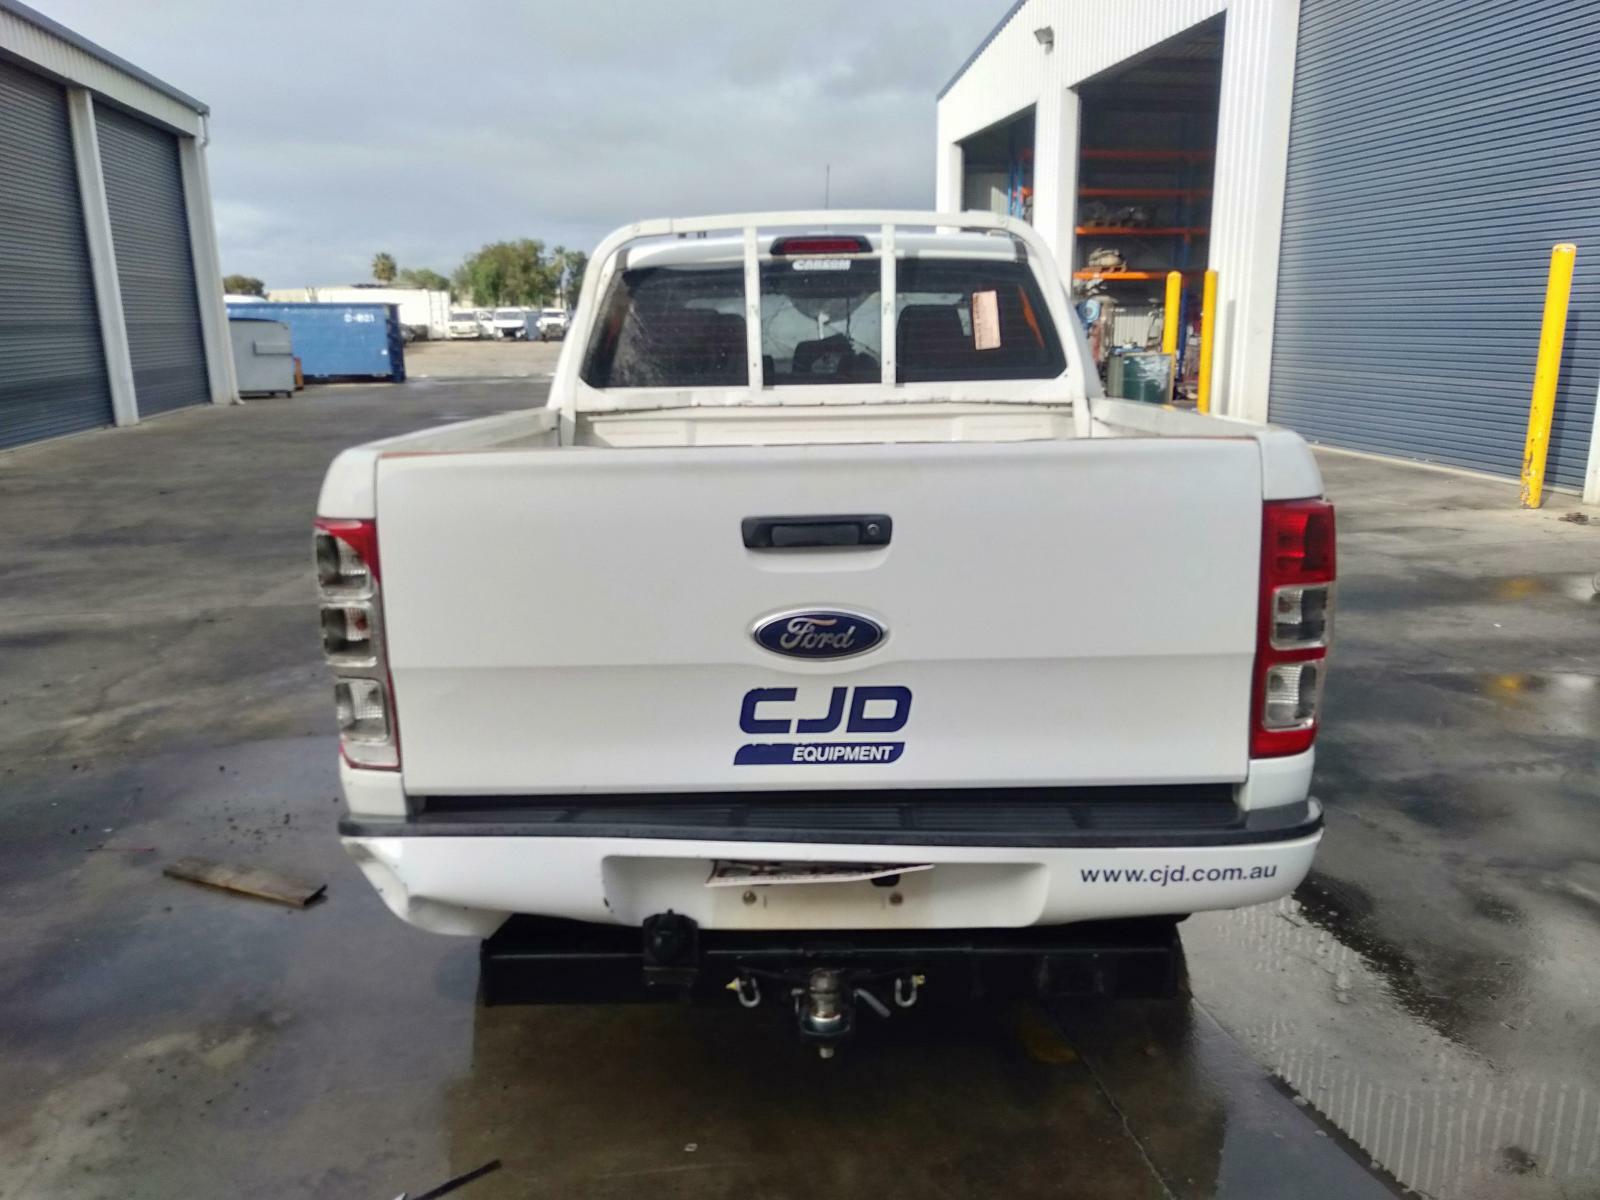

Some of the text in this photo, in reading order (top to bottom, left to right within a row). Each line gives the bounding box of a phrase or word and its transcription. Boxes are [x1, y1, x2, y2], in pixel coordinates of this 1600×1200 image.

[780, 616, 857, 649] Ford
[739, 685, 913, 734] CJD
[792, 745, 895, 762] EQUIPMENT
[1080, 864, 1278, 887] www.cjd.com.au
